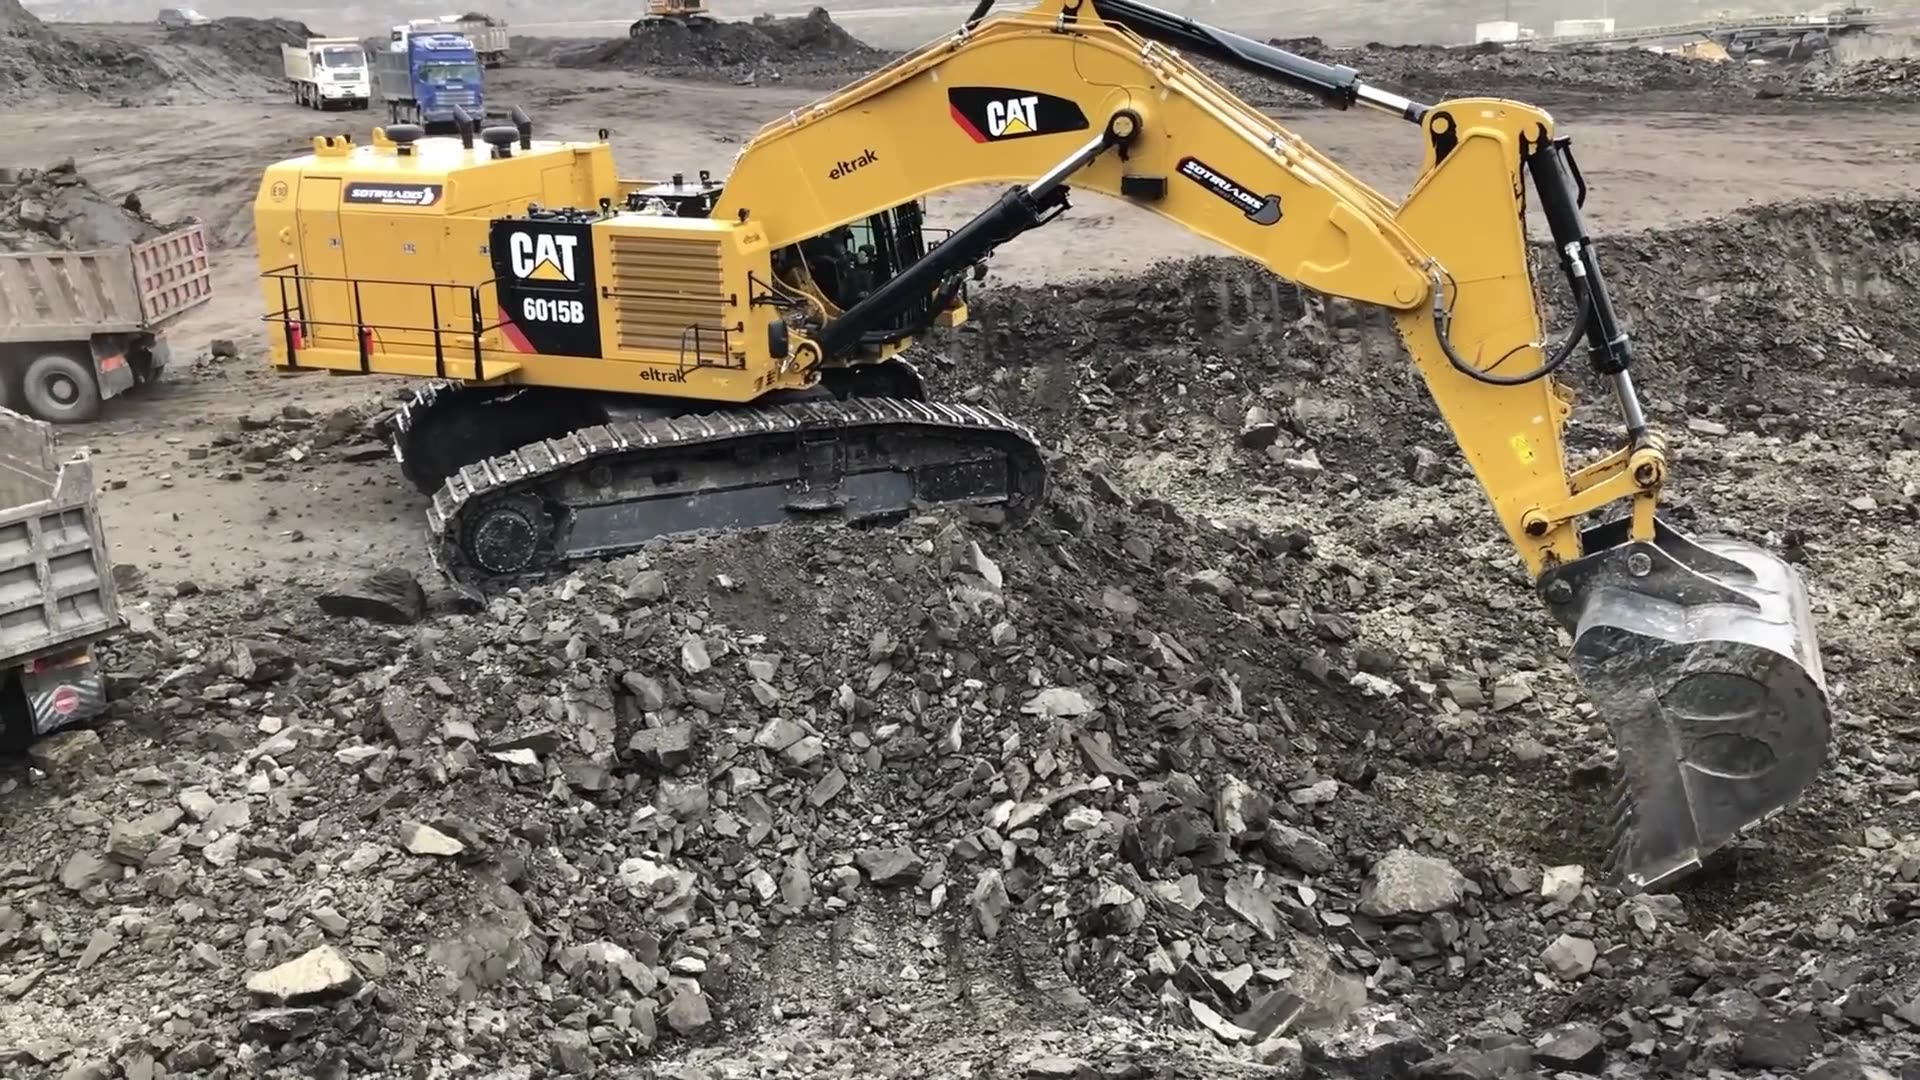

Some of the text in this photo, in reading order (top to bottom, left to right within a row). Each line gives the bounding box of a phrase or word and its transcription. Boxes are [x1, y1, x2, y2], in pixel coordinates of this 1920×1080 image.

[986, 96, 1039, 137] CAT
[828, 148, 879, 180] eltrak
[1184, 160, 1265, 210] SOTIRIADIS
[510, 231, 578, 282] CAT
[523, 297, 585, 324] 6015B
[640, 366, 687, 384] eltrak
